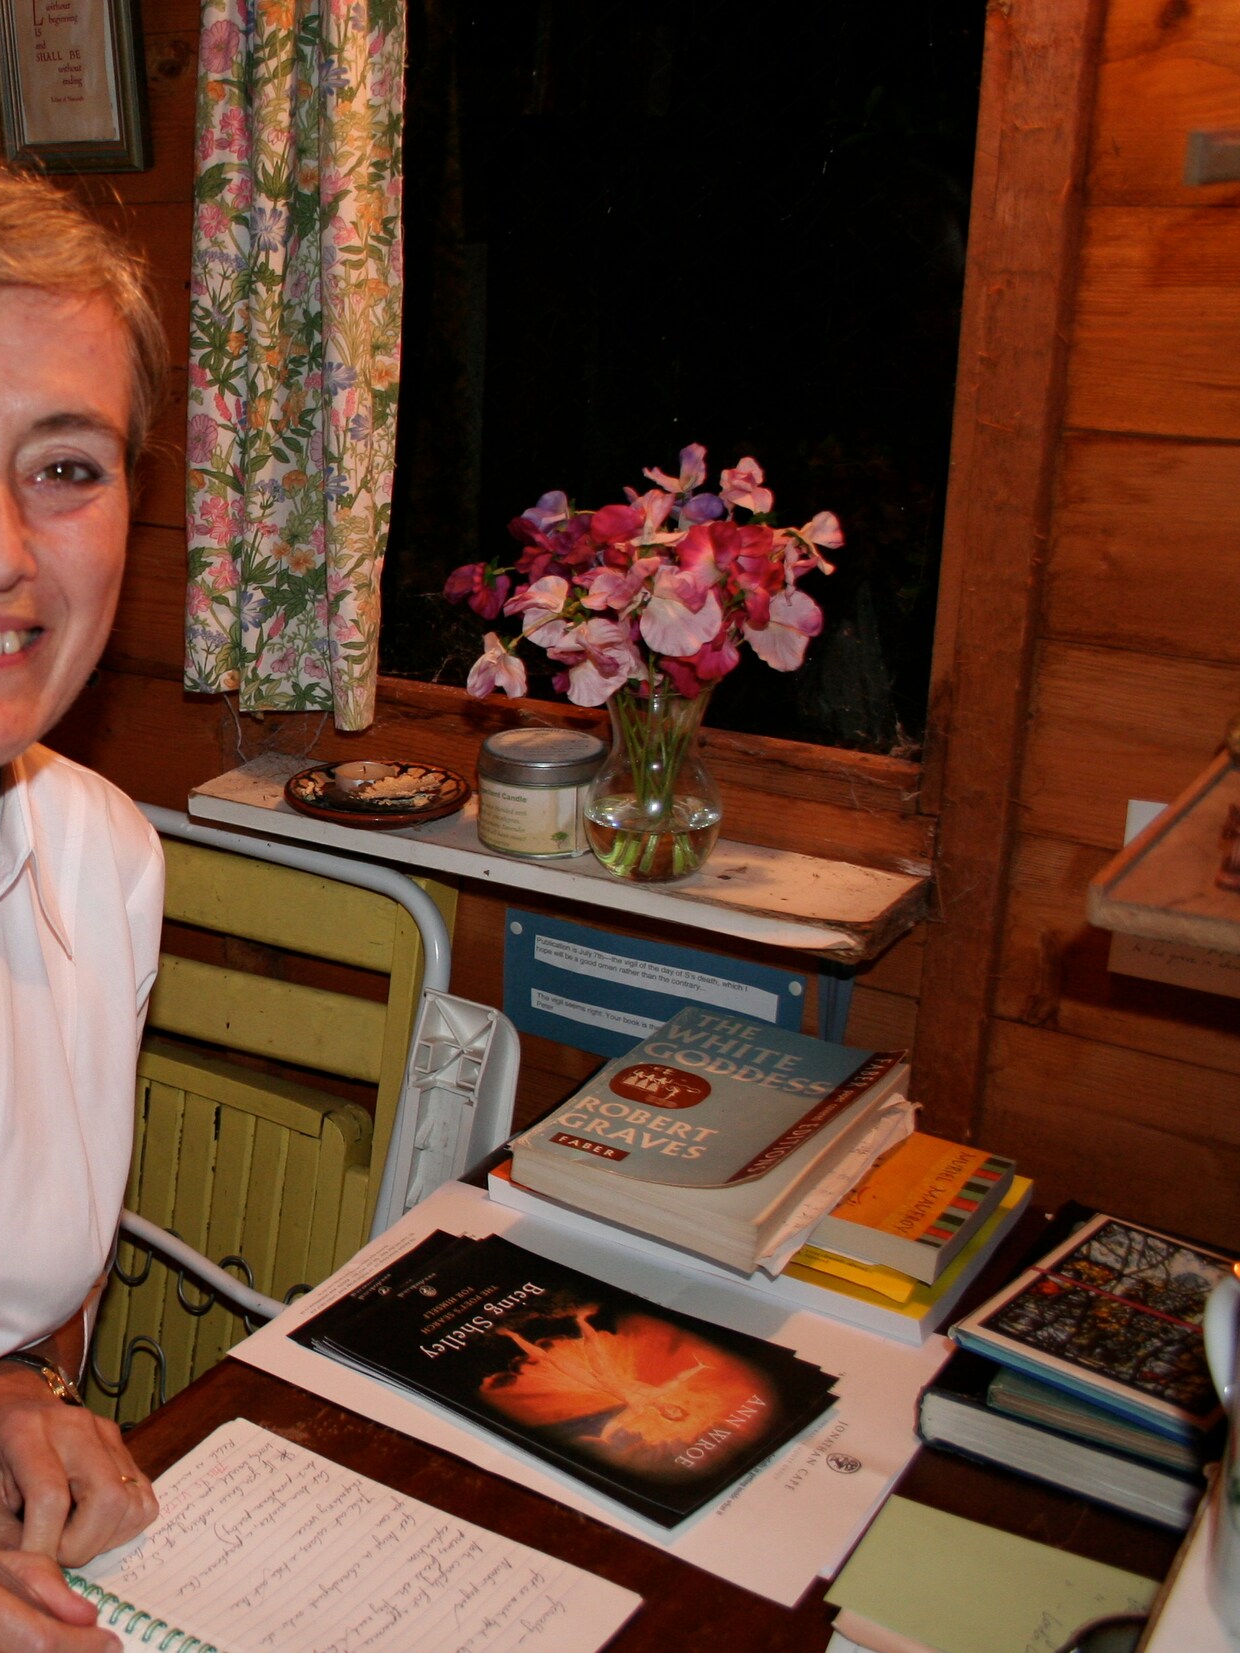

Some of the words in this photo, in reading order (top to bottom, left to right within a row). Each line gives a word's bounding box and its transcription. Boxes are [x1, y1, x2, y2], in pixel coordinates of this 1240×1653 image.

[36, 51, 63, 62] SHALL
[69, 50, 81, 60] BE
[697, 1014, 768, 1040] THE
[667, 1024, 803, 1071] WHITE
[644, 1042, 835, 1097] GODDESS
[848, 1058, 892, 1087] FABER
[575, 1095, 719, 1141] ROBERT
[557, 1135, 616, 1158] FABER
[558, 1112, 707, 1161] GRAVES
[747, 1123, 820, 1173] EDITIONS
[459, 1286, 474, 1299] FOR
[480, 1285, 500, 1297] THE
[483, 1282, 545, 1315] Being
[420, 1312, 455, 1334] SEARCH
[423, 1297, 457, 1319] HIMSELF
[420, 1316, 493, 1358] Shelley
[726, 1394, 766, 1428] ANN
[675, 1427, 731, 1468] WROE
[807, 1420, 848, 1466] JONATHAN
[784, 1468, 808, 1491] CAPE
